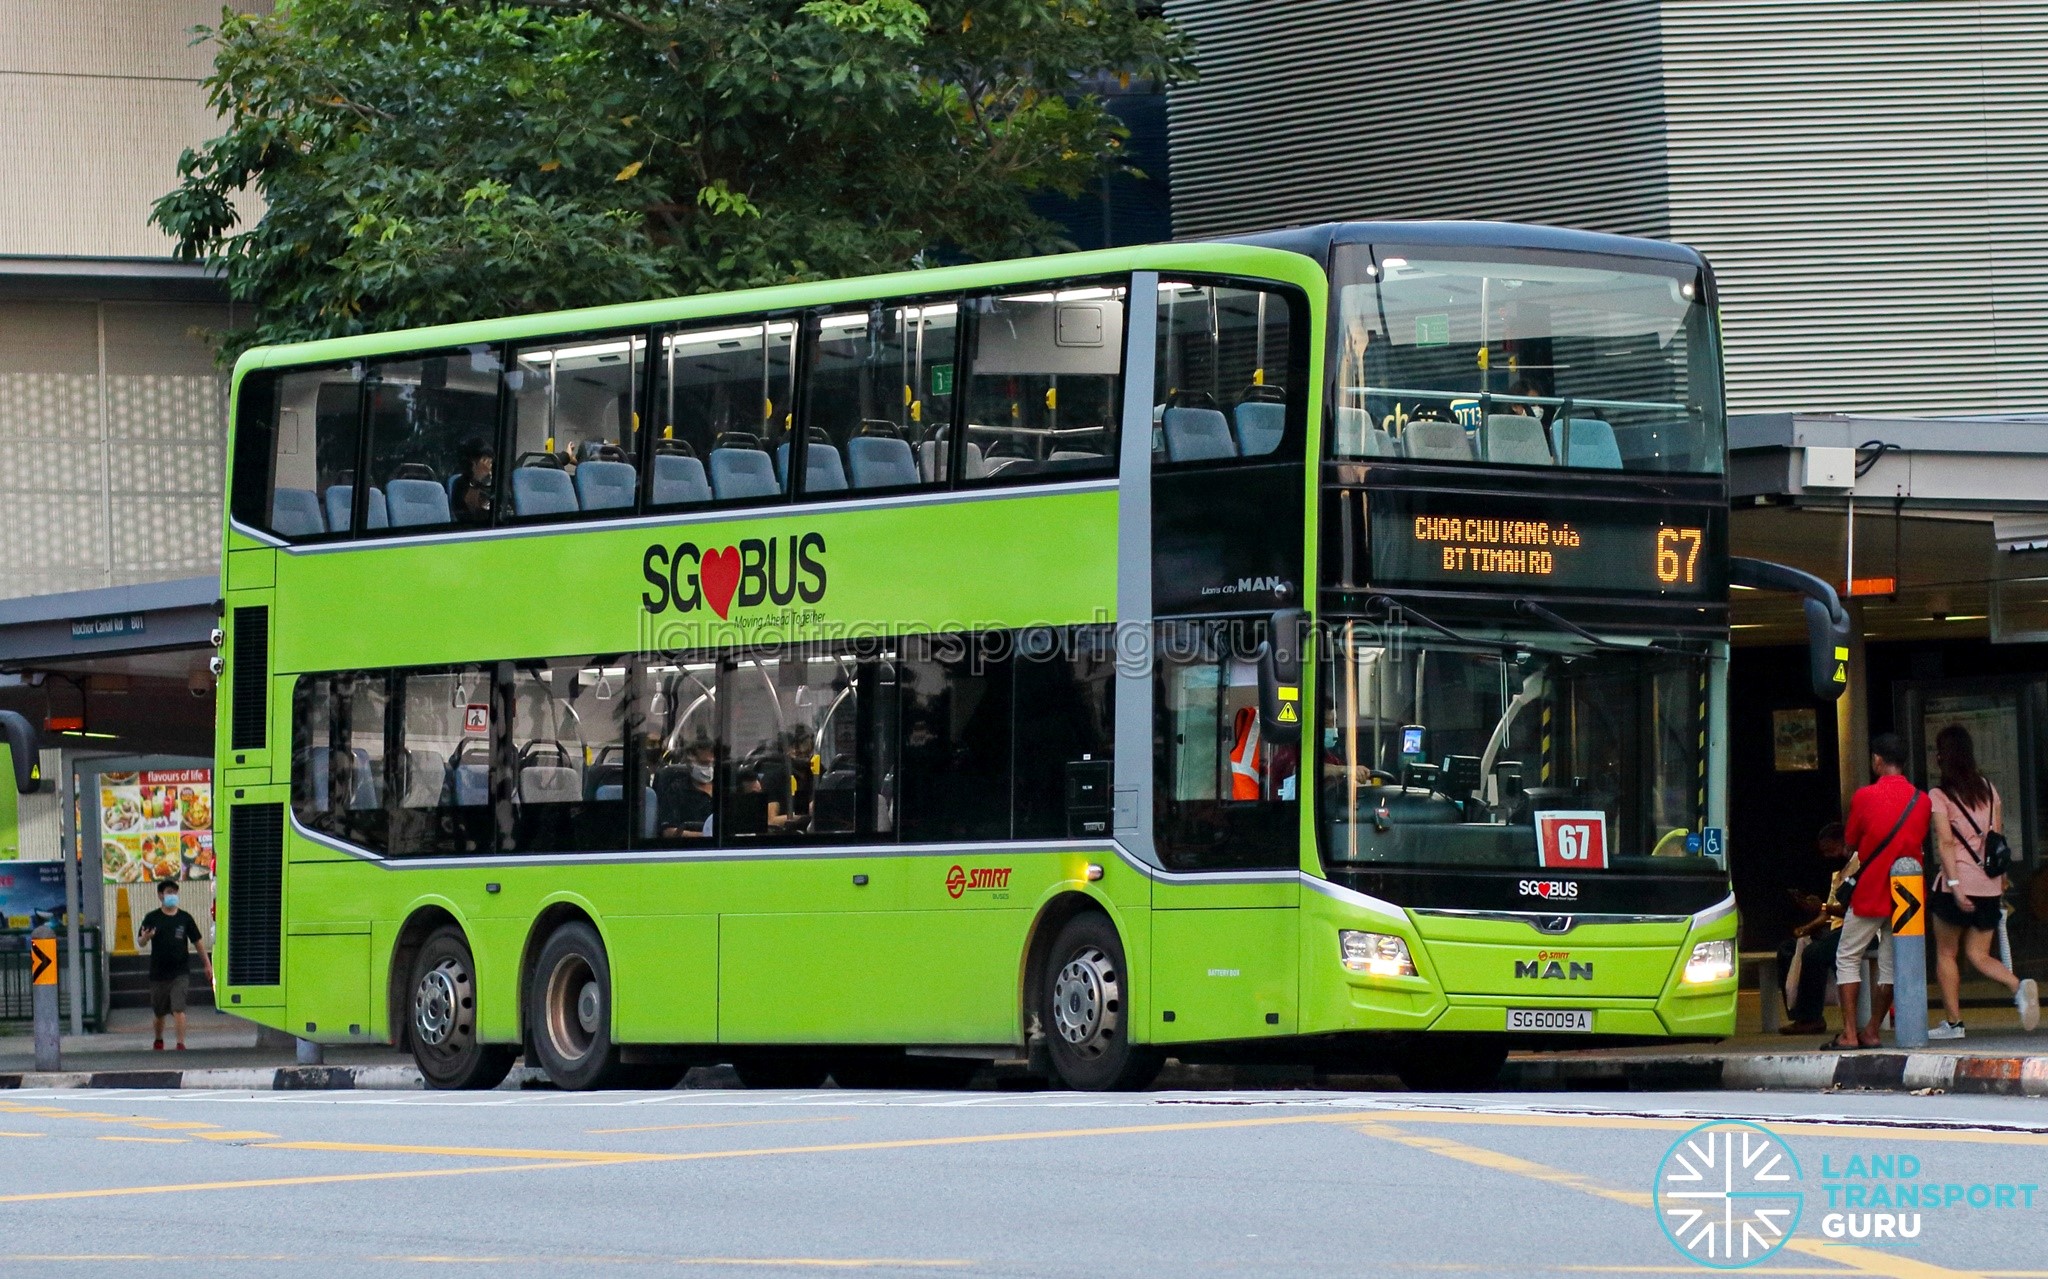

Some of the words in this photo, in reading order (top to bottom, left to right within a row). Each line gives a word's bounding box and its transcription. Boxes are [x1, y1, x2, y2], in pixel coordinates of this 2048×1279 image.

[1415, 517, 1462, 541] CHOA
[1465, 518, 1500, 543] CHU
[1503, 520, 1549, 545] KANG
[1552, 523, 1580, 547] via
[1443, 547, 1466, 571] BT
[1471, 548, 1526, 574] TIMAH
[1529, 551, 1553, 574] RD
[1657, 528, 1702, 583] 67
[1222, 585, 1238, 594] City
[1238, 576, 1280, 592] MAN
[72, 621, 94, 635] Rochor
[95, 619, 114, 633] Canal
[114, 617, 123, 631] Rd
[734, 614, 764, 630] Moving
[764, 613, 791, 627] Ahead
[792, 610, 826, 627] Together
[148, 771, 179, 782] flavours
[181, 769, 189, 781] of
[190, 769, 204, 781] life
[1558, 824, 1590, 860] 67
[967, 868, 1012, 888] SMRT
[1515, 960, 1593, 980] MAN
[1513, 1012, 1586, 1028] SG6009A
